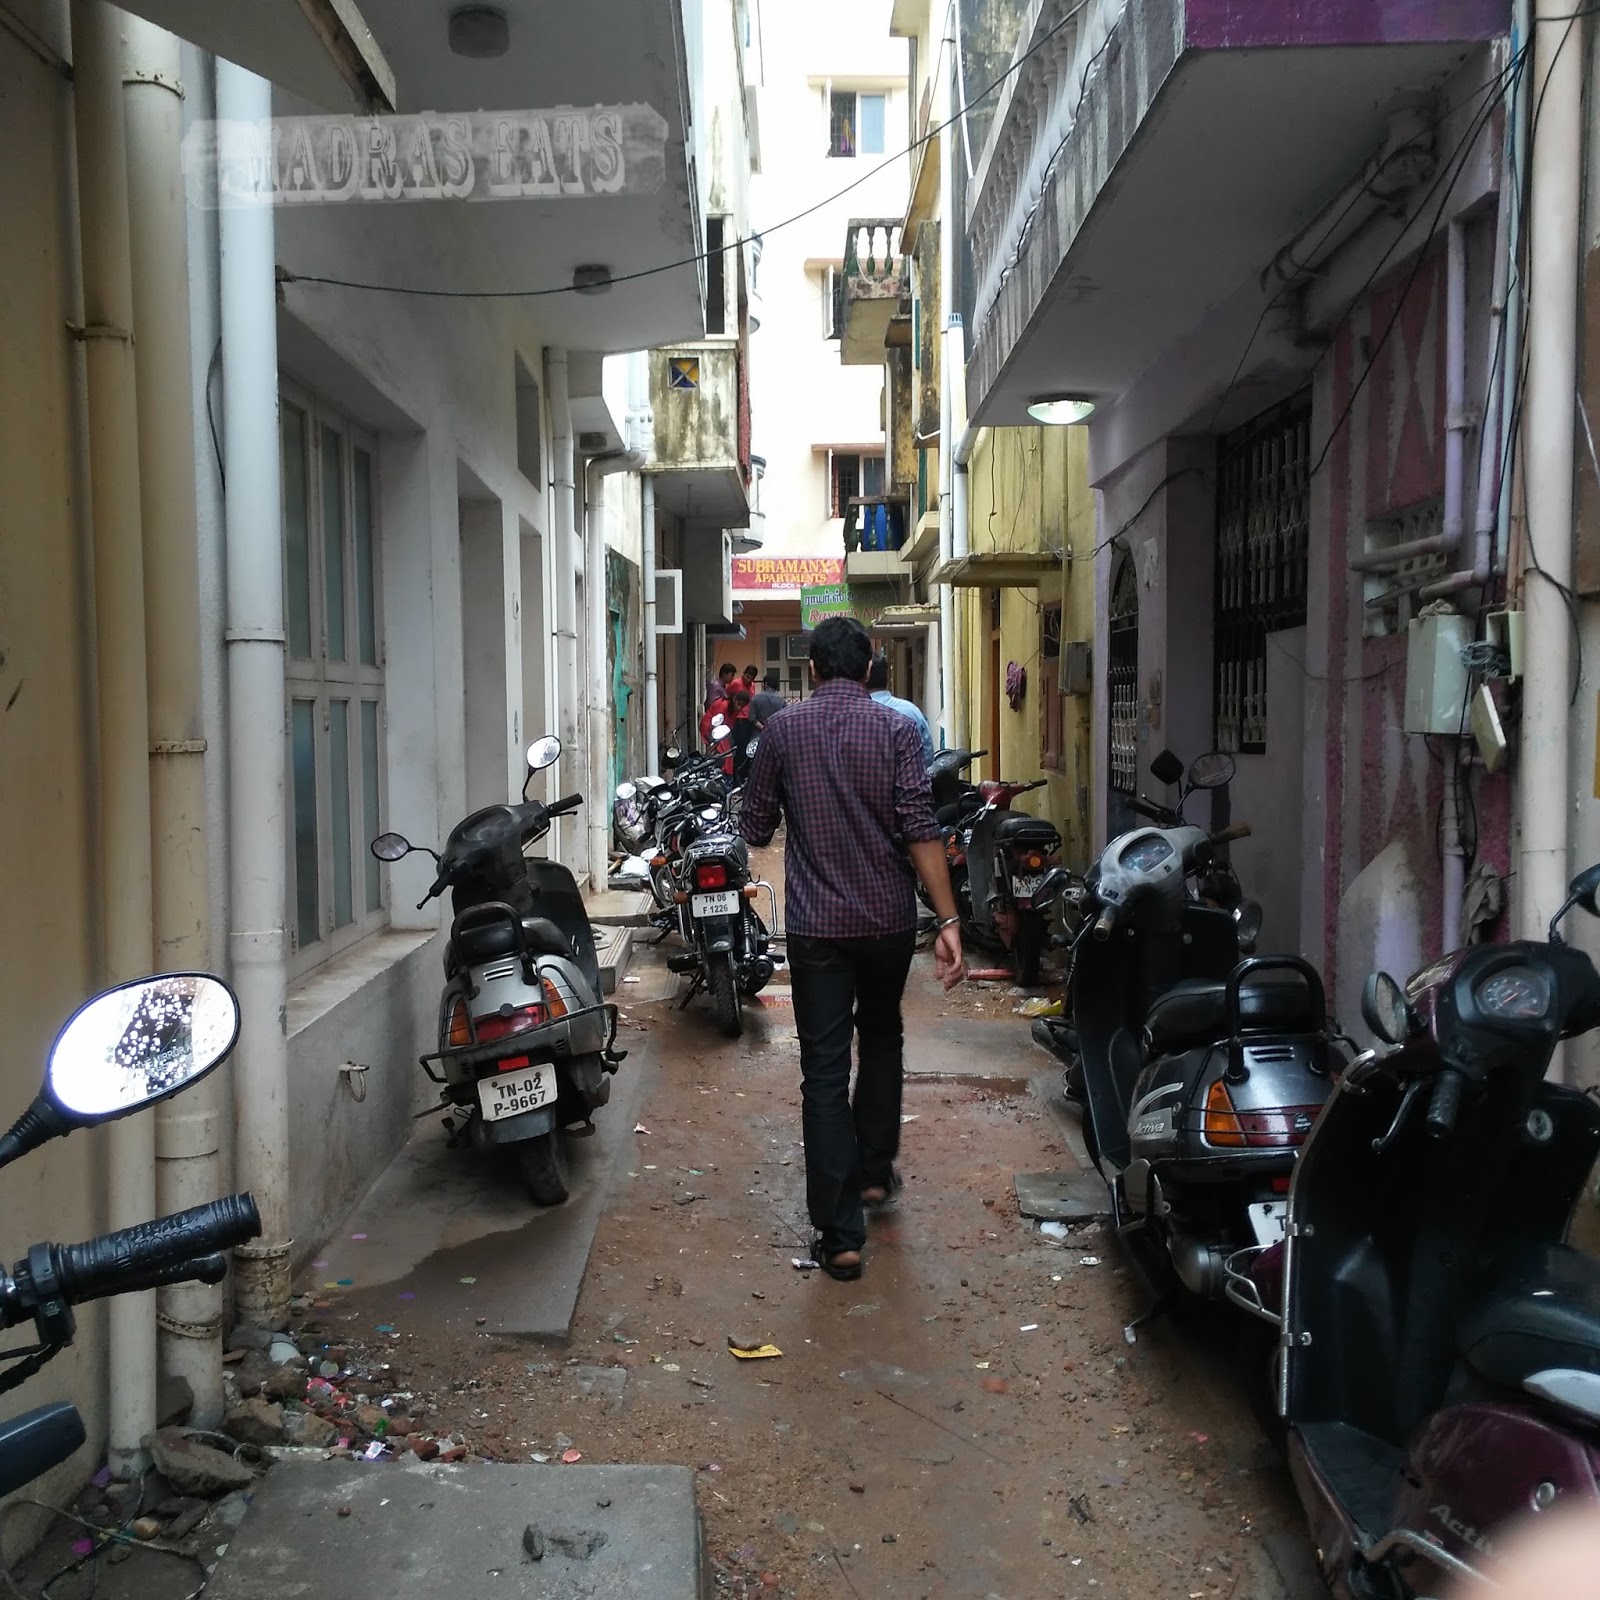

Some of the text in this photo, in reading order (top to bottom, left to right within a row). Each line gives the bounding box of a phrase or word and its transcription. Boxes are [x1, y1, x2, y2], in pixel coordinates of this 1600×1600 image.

[738, 559, 841, 573] SUBRAMANYA
[755, 573, 827, 583] APARTMENTS
[704, 895, 715, 903] TN
[703, 904, 729, 914] F 1226
[497, 1077, 543, 1099] TN-02
[493, 1091, 546, 1116] P-9667
[1133, 1122, 1165, 1137] Activa
